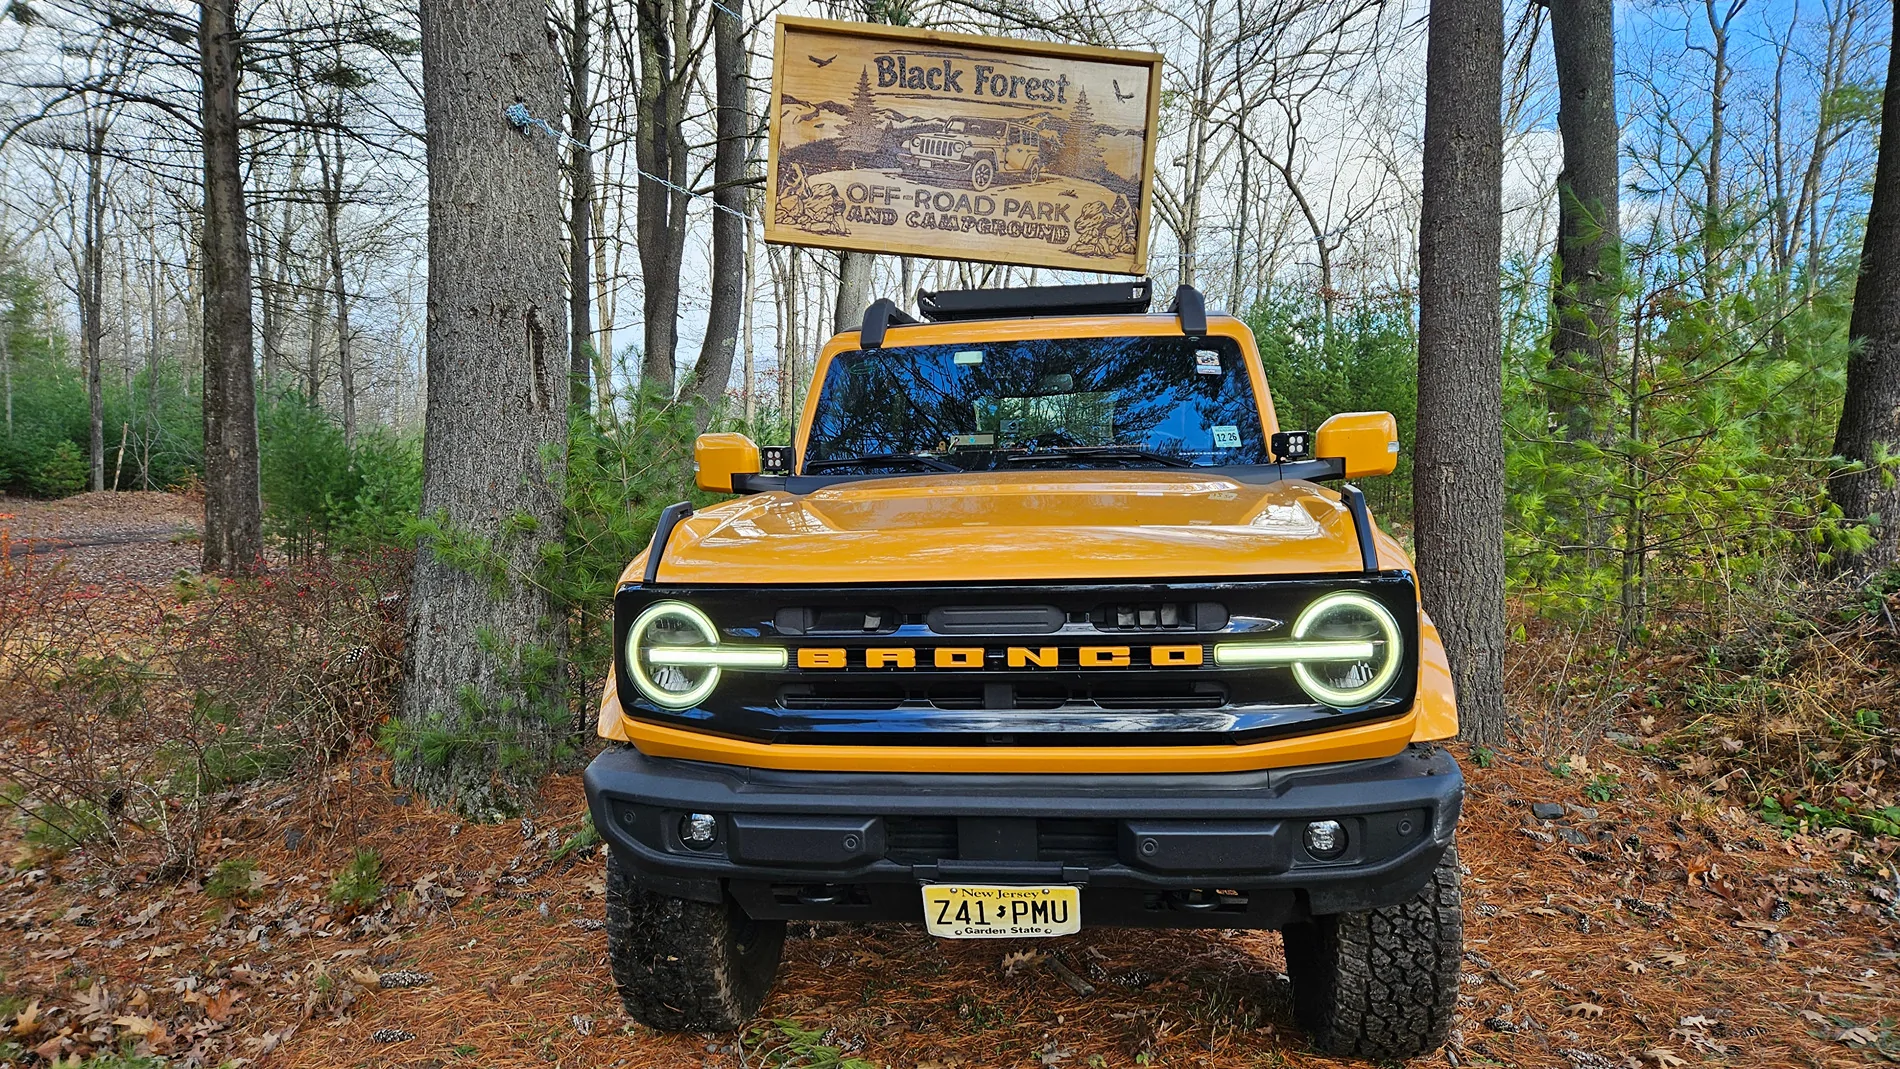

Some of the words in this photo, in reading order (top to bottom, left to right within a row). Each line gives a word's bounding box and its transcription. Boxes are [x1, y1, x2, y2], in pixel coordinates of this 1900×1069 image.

[873, 55, 963, 94] Black
[974, 64, 1071, 104] Forest
[846, 182, 996, 216] OFF-ROAD
[1003, 198, 1071, 223] PARK
[846, 205, 898, 226] AND
[905, 211, 1070, 244] CAMPGROUND
[1216, 433, 1227, 442] 12
[1228, 432, 1238, 441] 26
[797, 644, 1203, 669] BRONCO
[961, 888, 994, 898] New
[996, 889, 1040, 900] Jersey
[934, 900, 991, 926] Z41
[1011, 900, 1068, 925] PMU
[964, 926, 1007, 935] Garden
[1010, 926, 1042, 935] State
